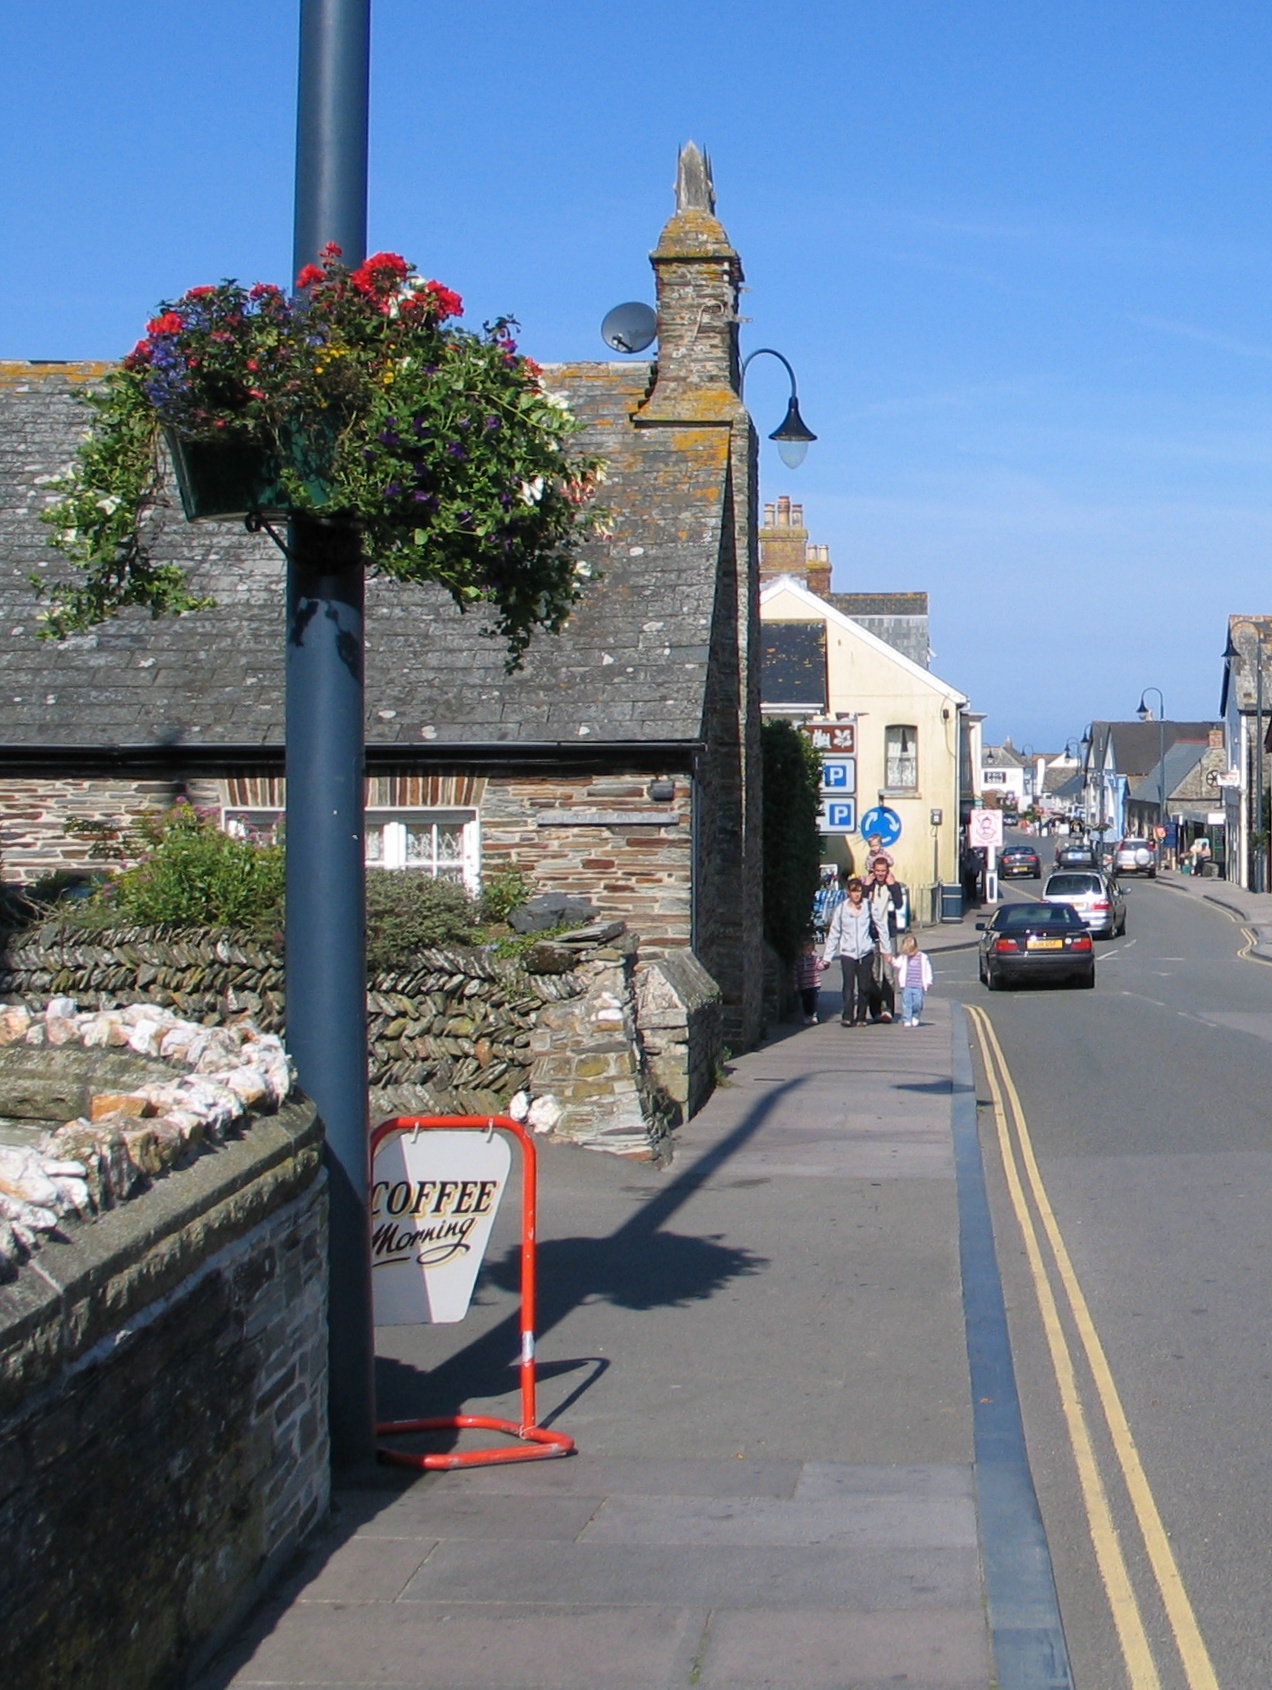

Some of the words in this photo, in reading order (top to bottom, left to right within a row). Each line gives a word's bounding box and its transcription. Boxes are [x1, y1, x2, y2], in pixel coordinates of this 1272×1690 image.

[830, 767, 844, 785] P
[834, 806, 848, 824] P
[372, 1180, 499, 1217] COFFEE
[372, 1217, 476, 1264] Morning
